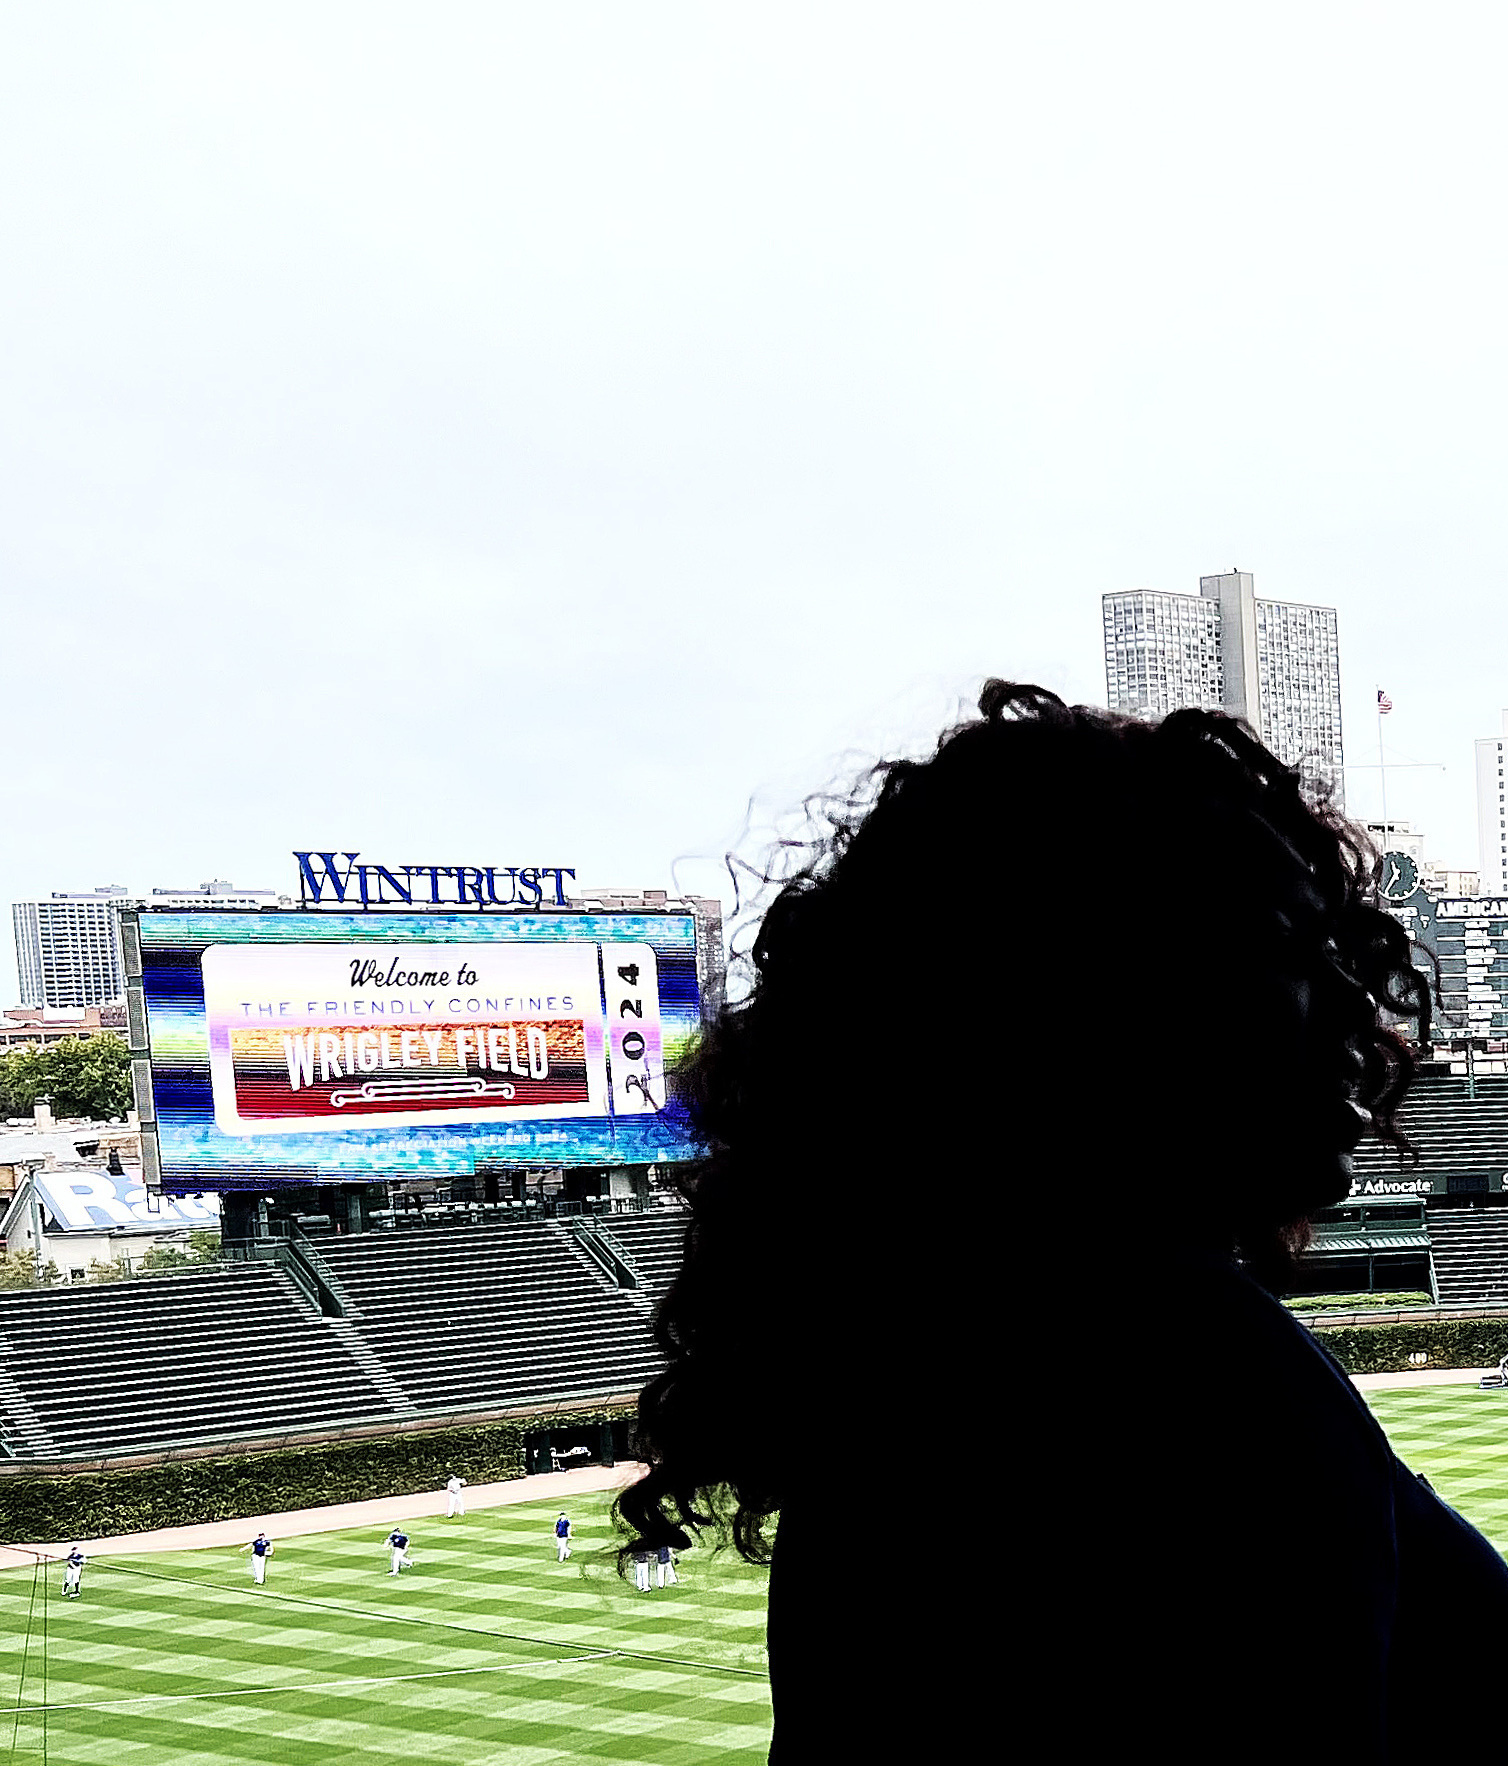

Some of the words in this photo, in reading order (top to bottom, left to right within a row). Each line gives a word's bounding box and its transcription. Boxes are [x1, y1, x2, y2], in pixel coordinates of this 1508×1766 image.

[292, 850, 576, 905] WINTRUST
[350, 957, 451, 987] Welcome
[457, 963, 479, 986] to
[239, 1001, 290, 1017] THE
[307, 999, 434, 1016] FRIENDLY
[448, 996, 574, 1013] CONFINES
[283, 1029, 443, 1092] WRIGLEY
[456, 1026, 550, 1081] FIELD
[1364, 1178, 1433, 1194] Advocate
